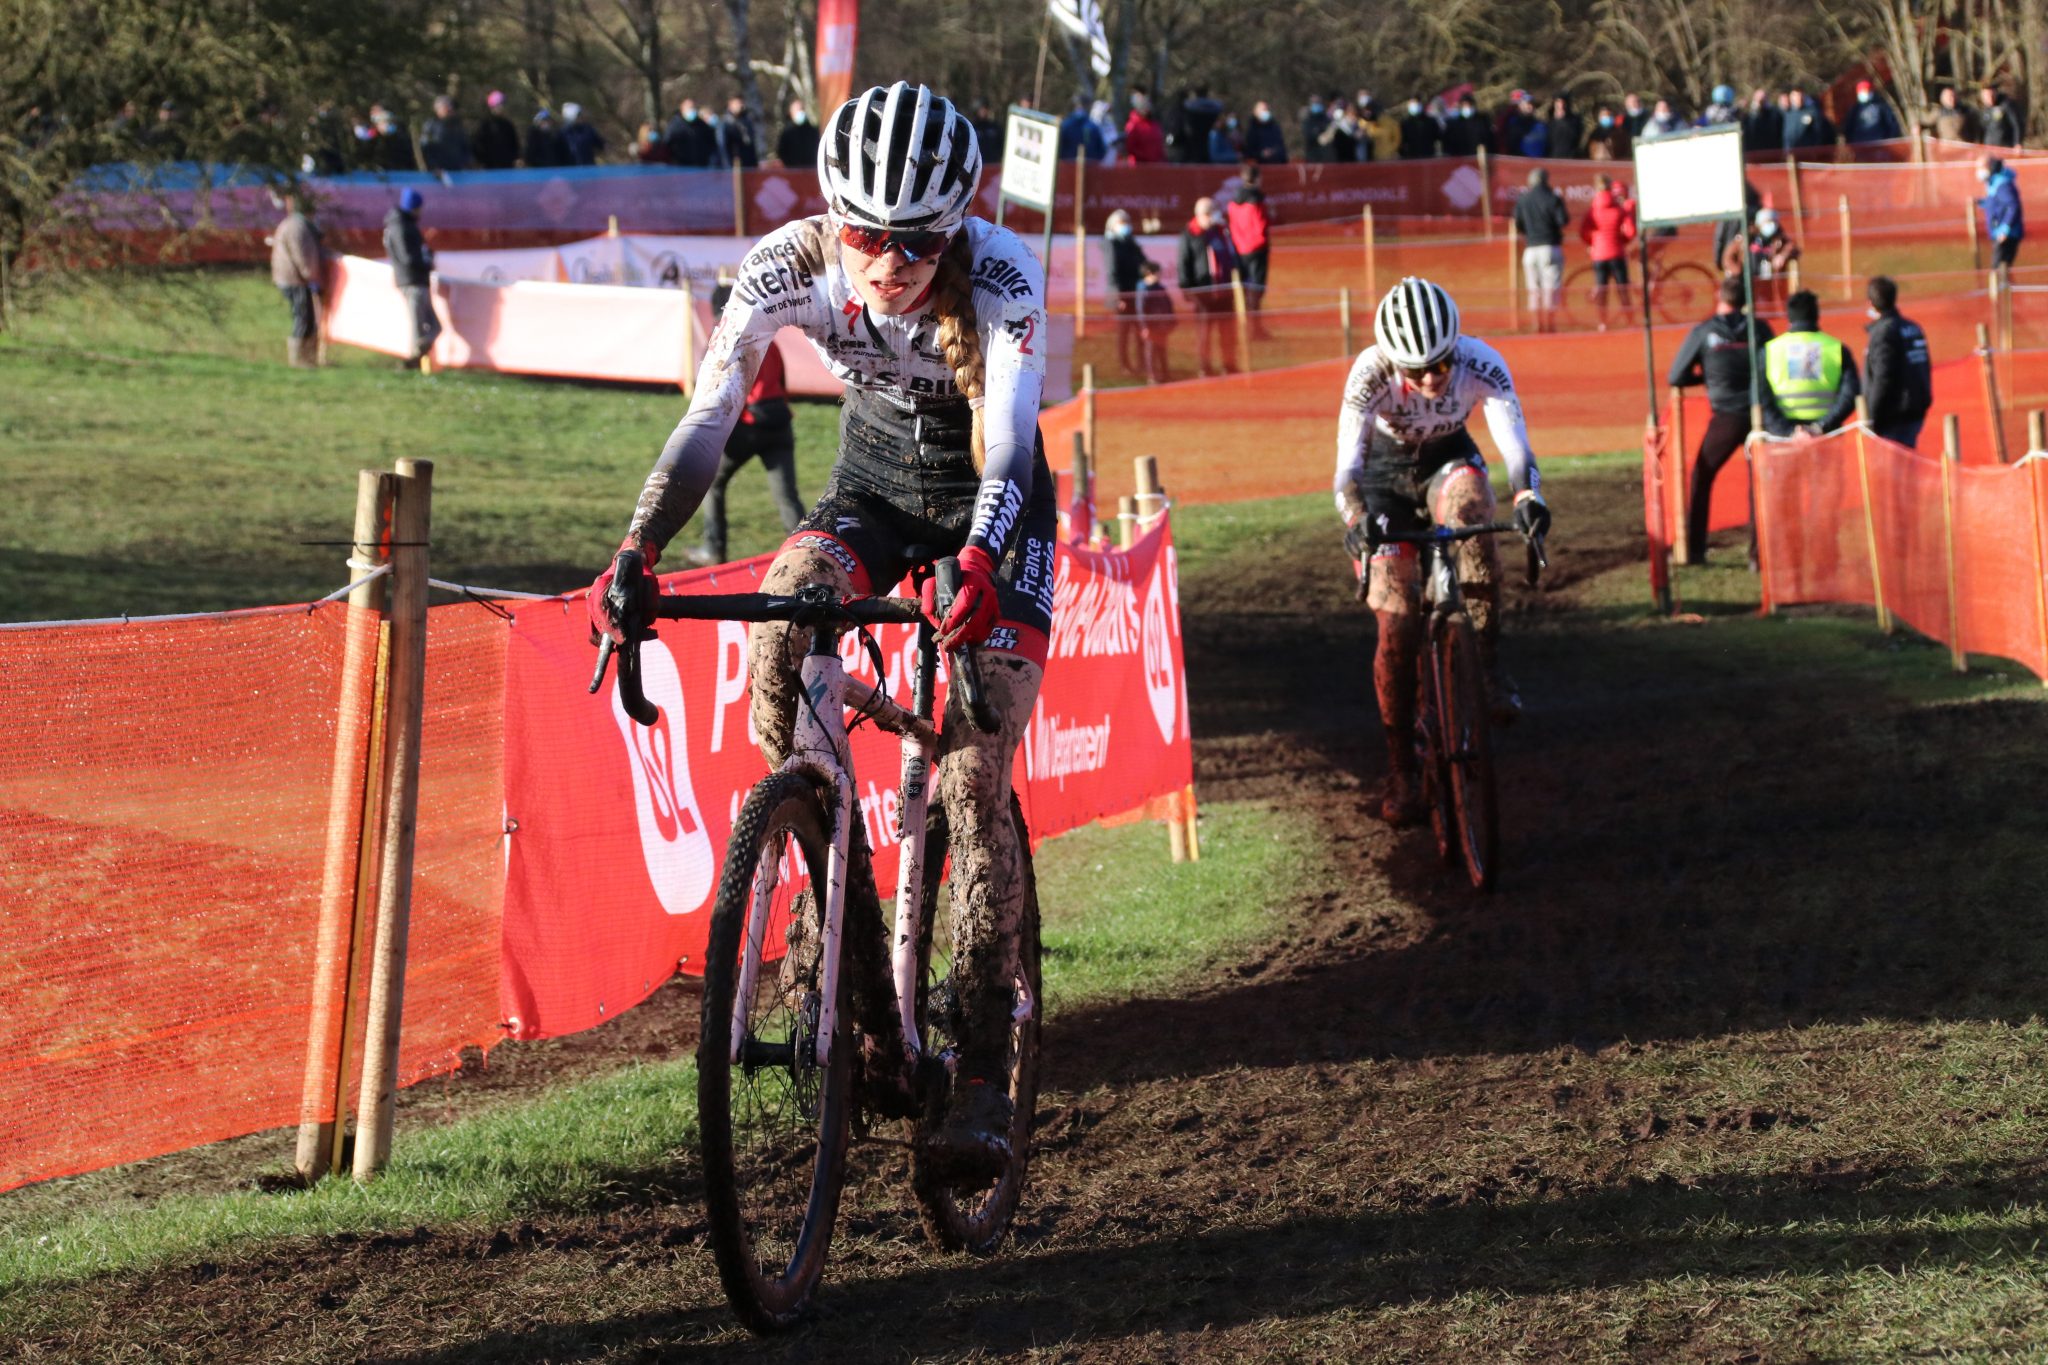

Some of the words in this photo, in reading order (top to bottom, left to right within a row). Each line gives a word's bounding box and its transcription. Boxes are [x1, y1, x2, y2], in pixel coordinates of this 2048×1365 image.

[739, 240, 797, 274] rance
[988, 478, 1024, 556] SPORT
[1015, 537, 1042, 597] France
